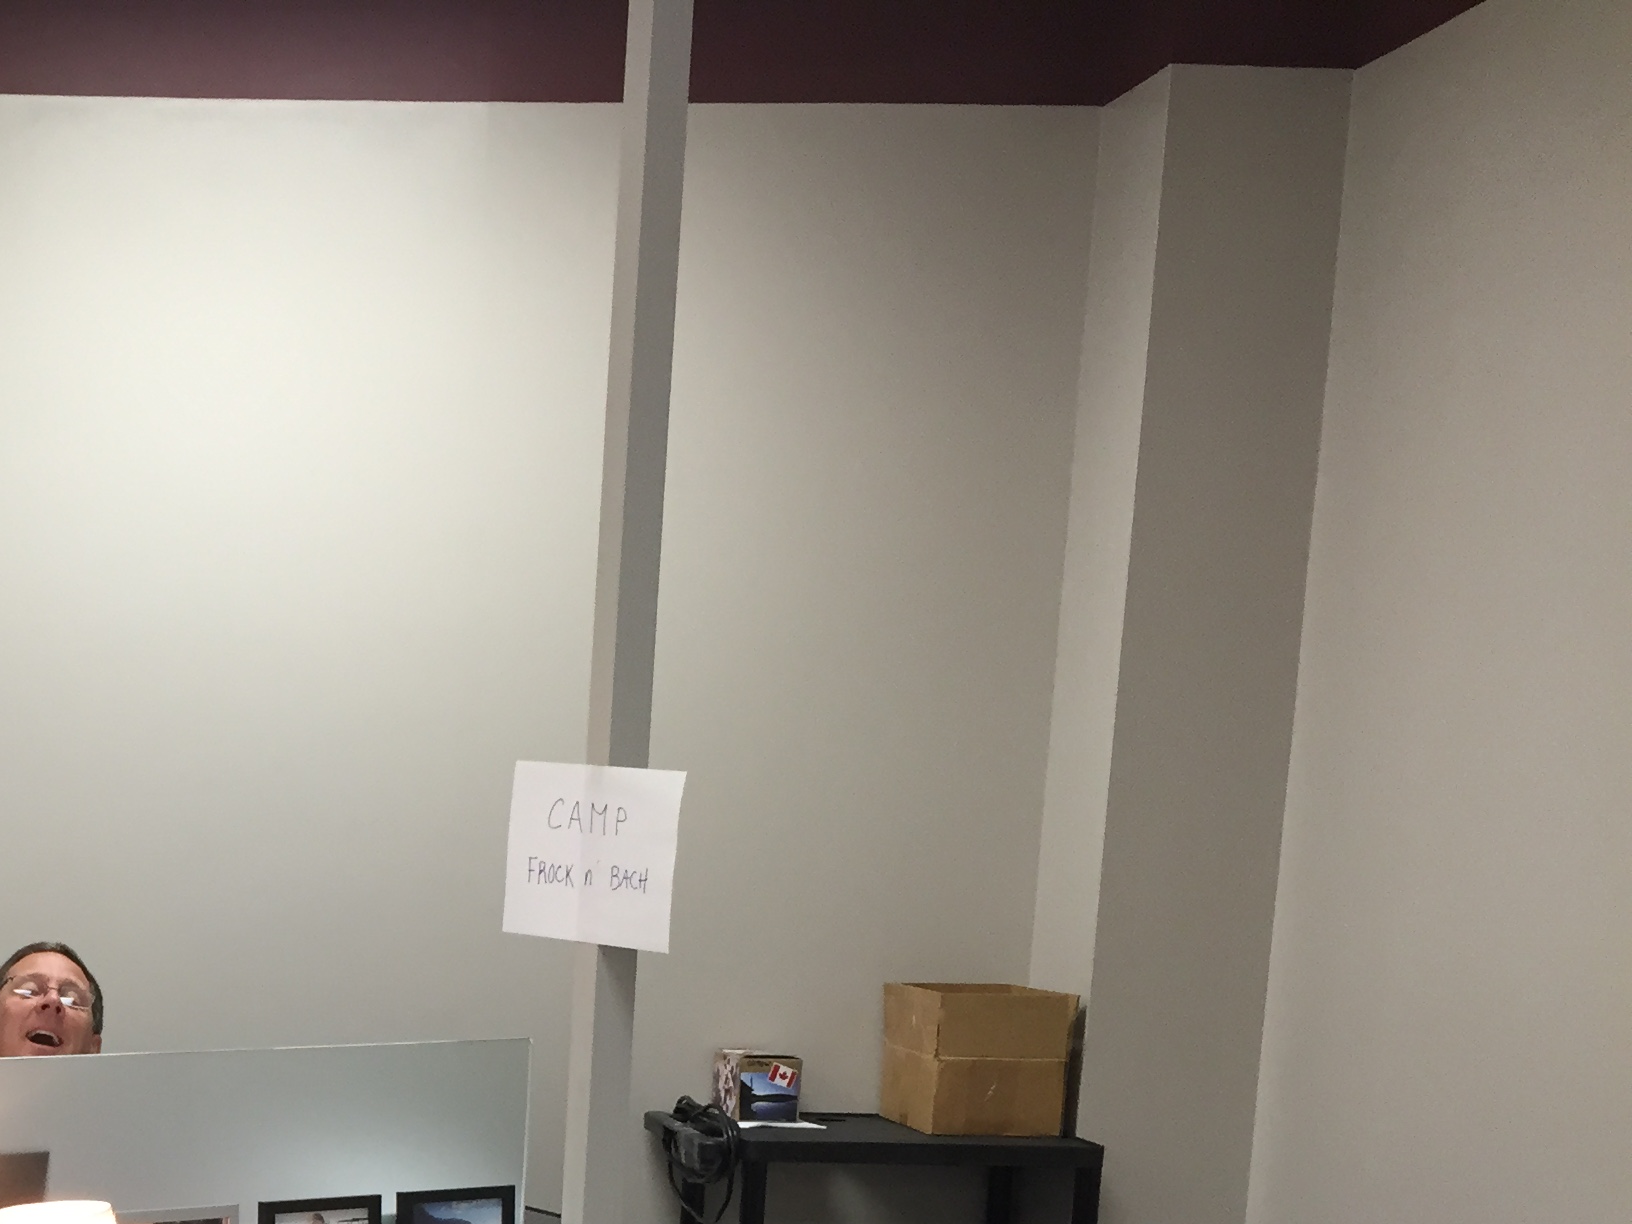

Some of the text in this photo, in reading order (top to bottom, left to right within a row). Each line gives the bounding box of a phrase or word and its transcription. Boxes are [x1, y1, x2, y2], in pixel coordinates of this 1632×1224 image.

[548, 798, 627, 836] CAMP
[527, 856, 575, 888] FROCK
[609, 865, 649, 894] BACH
